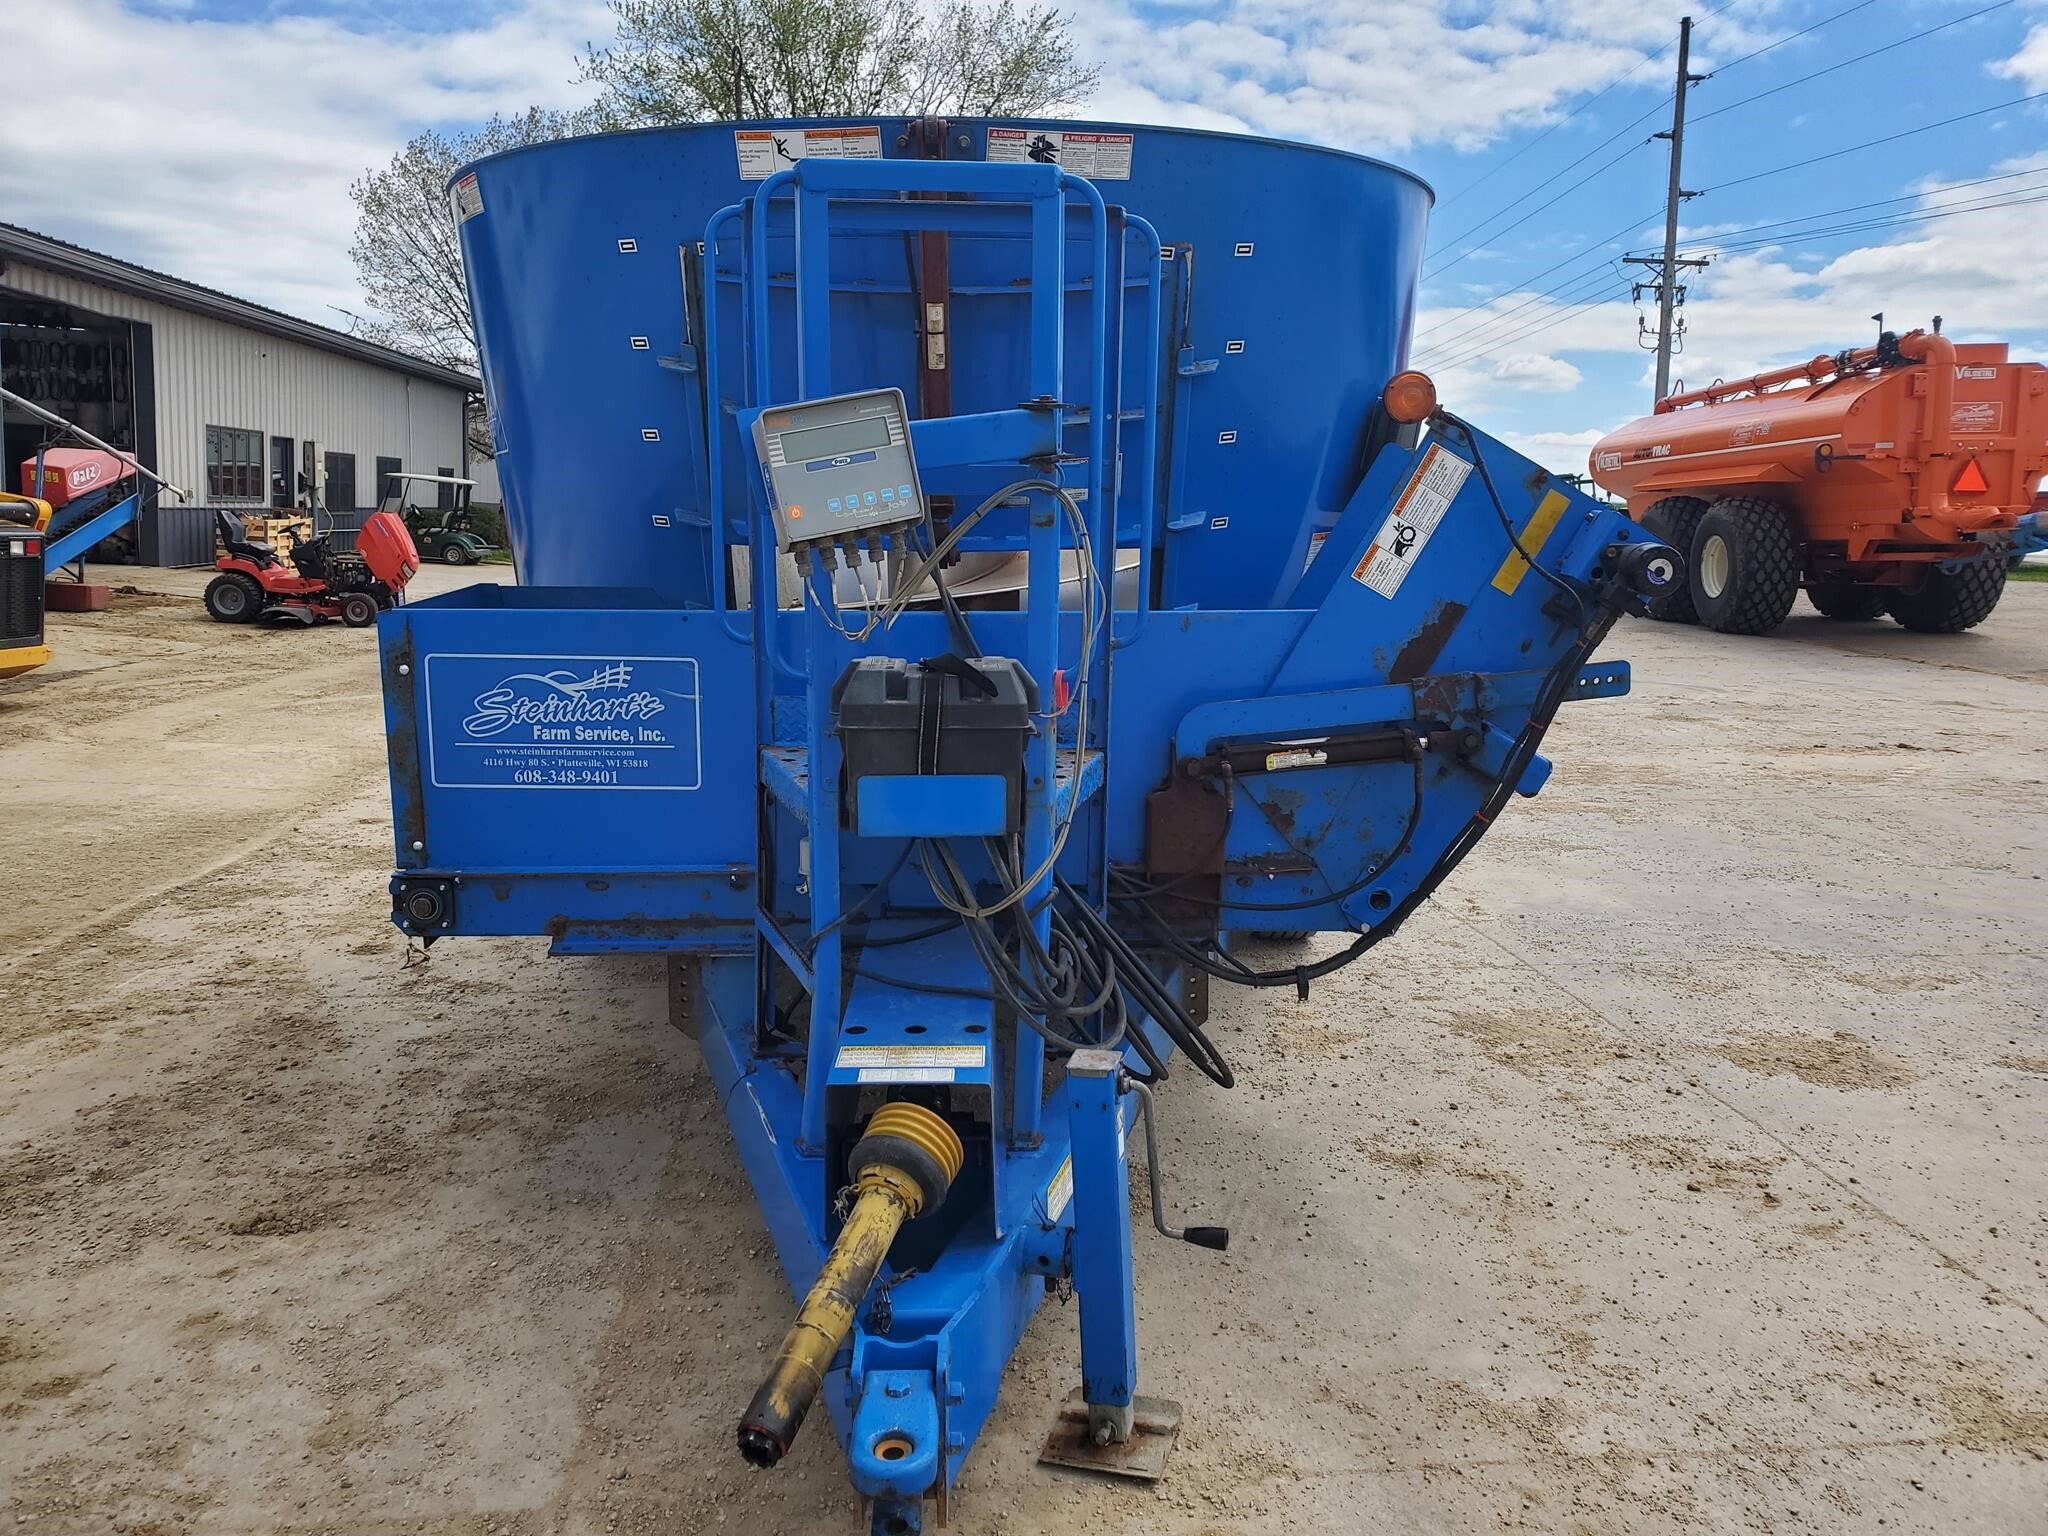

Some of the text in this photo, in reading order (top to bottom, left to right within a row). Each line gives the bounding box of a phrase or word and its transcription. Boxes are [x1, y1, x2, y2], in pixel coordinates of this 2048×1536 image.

[73, 467, 96, 486] Patz
[463, 688, 665, 738] Steinhart's
[533, 725, 666, 743] Farm Service, Inc.
[496, 748, 635, 757] www.steinhartsfarmservice.com
[483, 758, 649, 768] 4116 Hwy 80 S. Platteville, WI 53818
[514, 769, 619, 784] 608-348-9401
